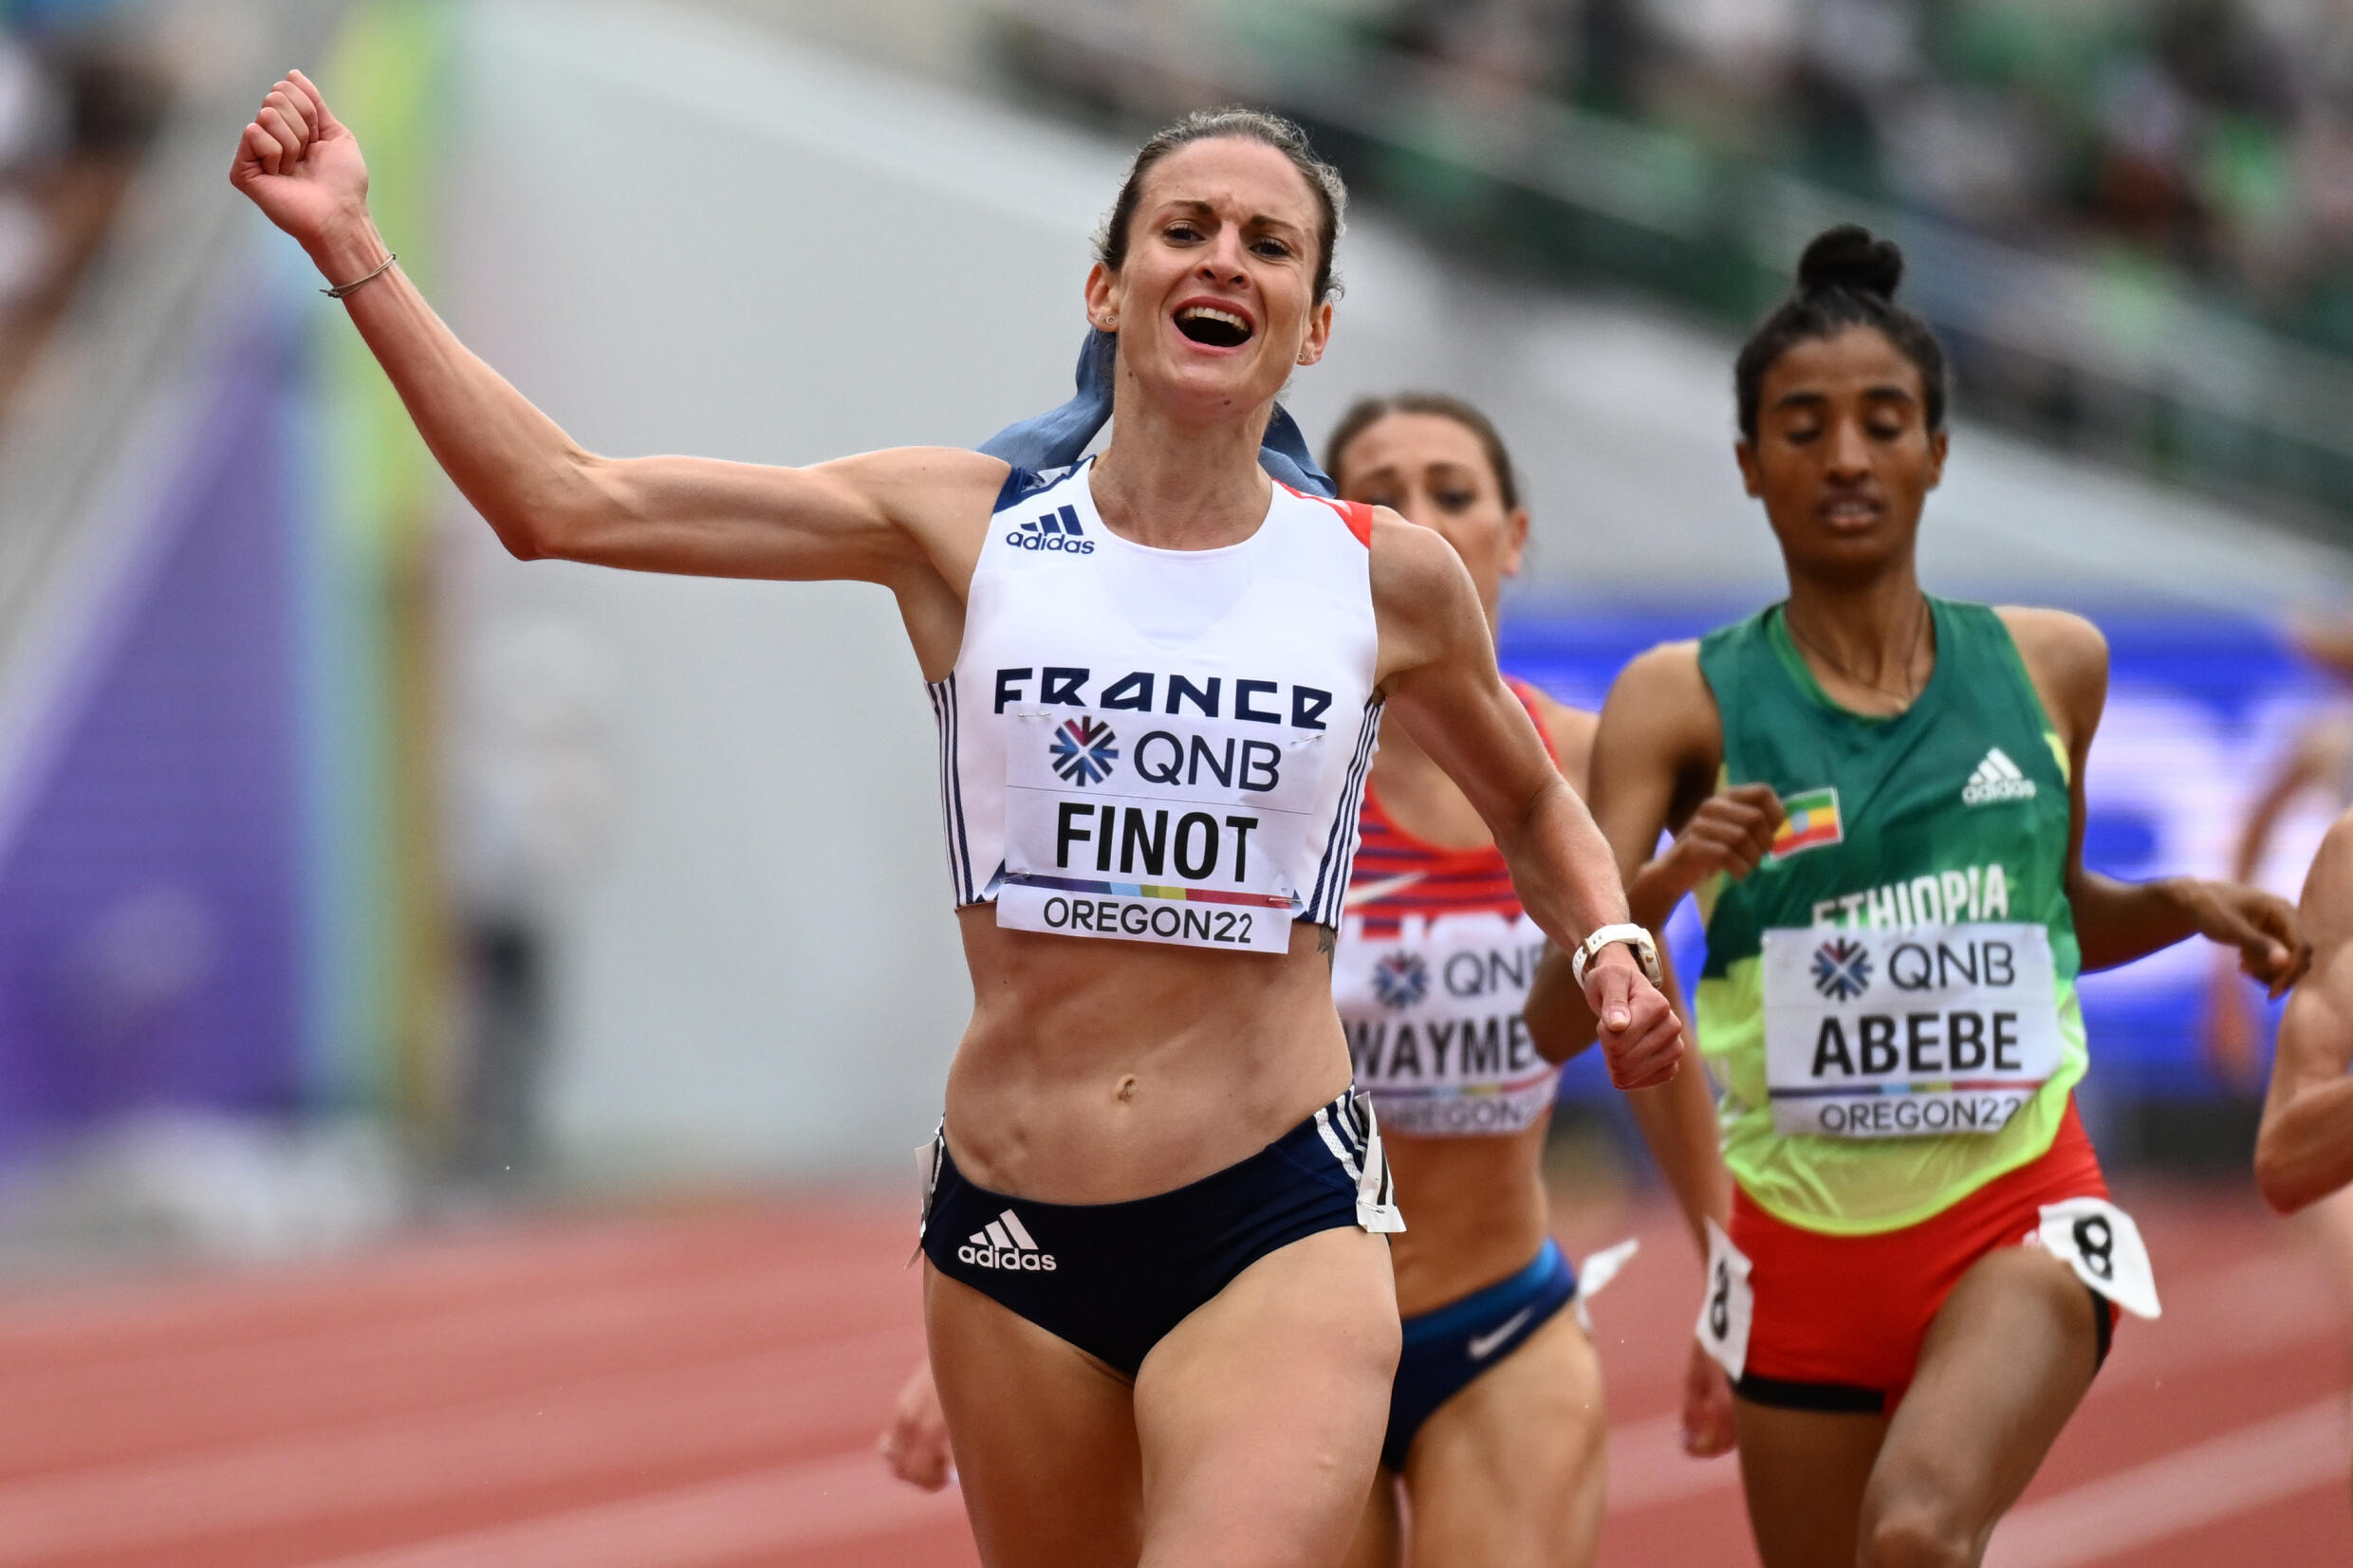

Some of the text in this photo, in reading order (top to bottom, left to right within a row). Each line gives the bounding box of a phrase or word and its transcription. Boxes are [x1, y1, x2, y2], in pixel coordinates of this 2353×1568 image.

[1006, 529, 1095, 555] adidas
[993, 667, 1334, 730] FRANCE
[1133, 730, 1282, 792] QNB
[1962, 778, 2036, 806] adidas
[1056, 802, 1259, 883] FINOT
[1043, 895, 1253, 944] OREGON22
[1812, 863, 2010, 933] ETHIOPIA
[1888, 940, 2016, 990] QNB
[1810, 1011, 2023, 1078] ABEBE
[1819, 1098, 2023, 1134] OREGON22
[957, 1244, 1058, 1272] adidas
[2072, 1214, 2114, 1282] 8
